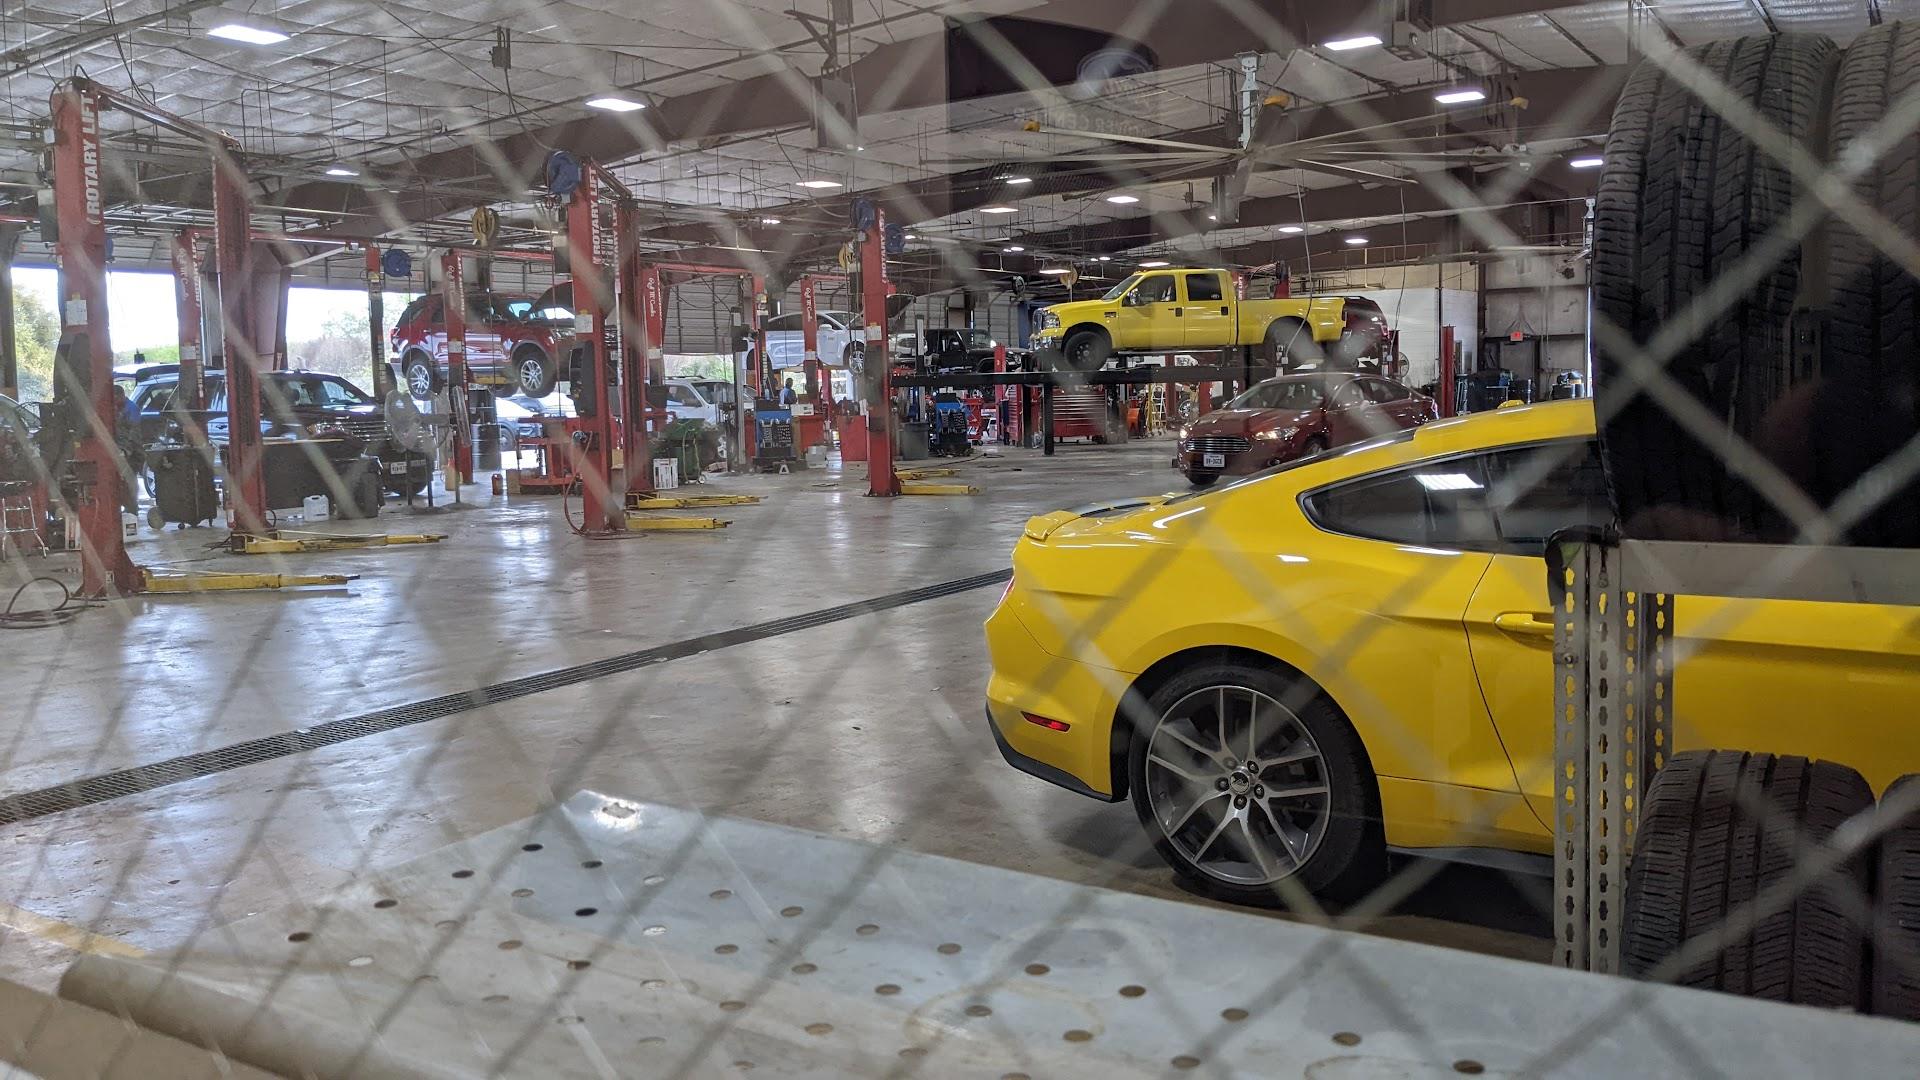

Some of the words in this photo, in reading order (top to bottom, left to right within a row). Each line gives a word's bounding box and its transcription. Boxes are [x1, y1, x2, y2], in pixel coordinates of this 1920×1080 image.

[80, 94, 97, 135] LIFT
[82, 138, 101, 215] ROTARY
[588, 166, 599, 196] LIFT
[590, 199, 602, 256] ROTARY
